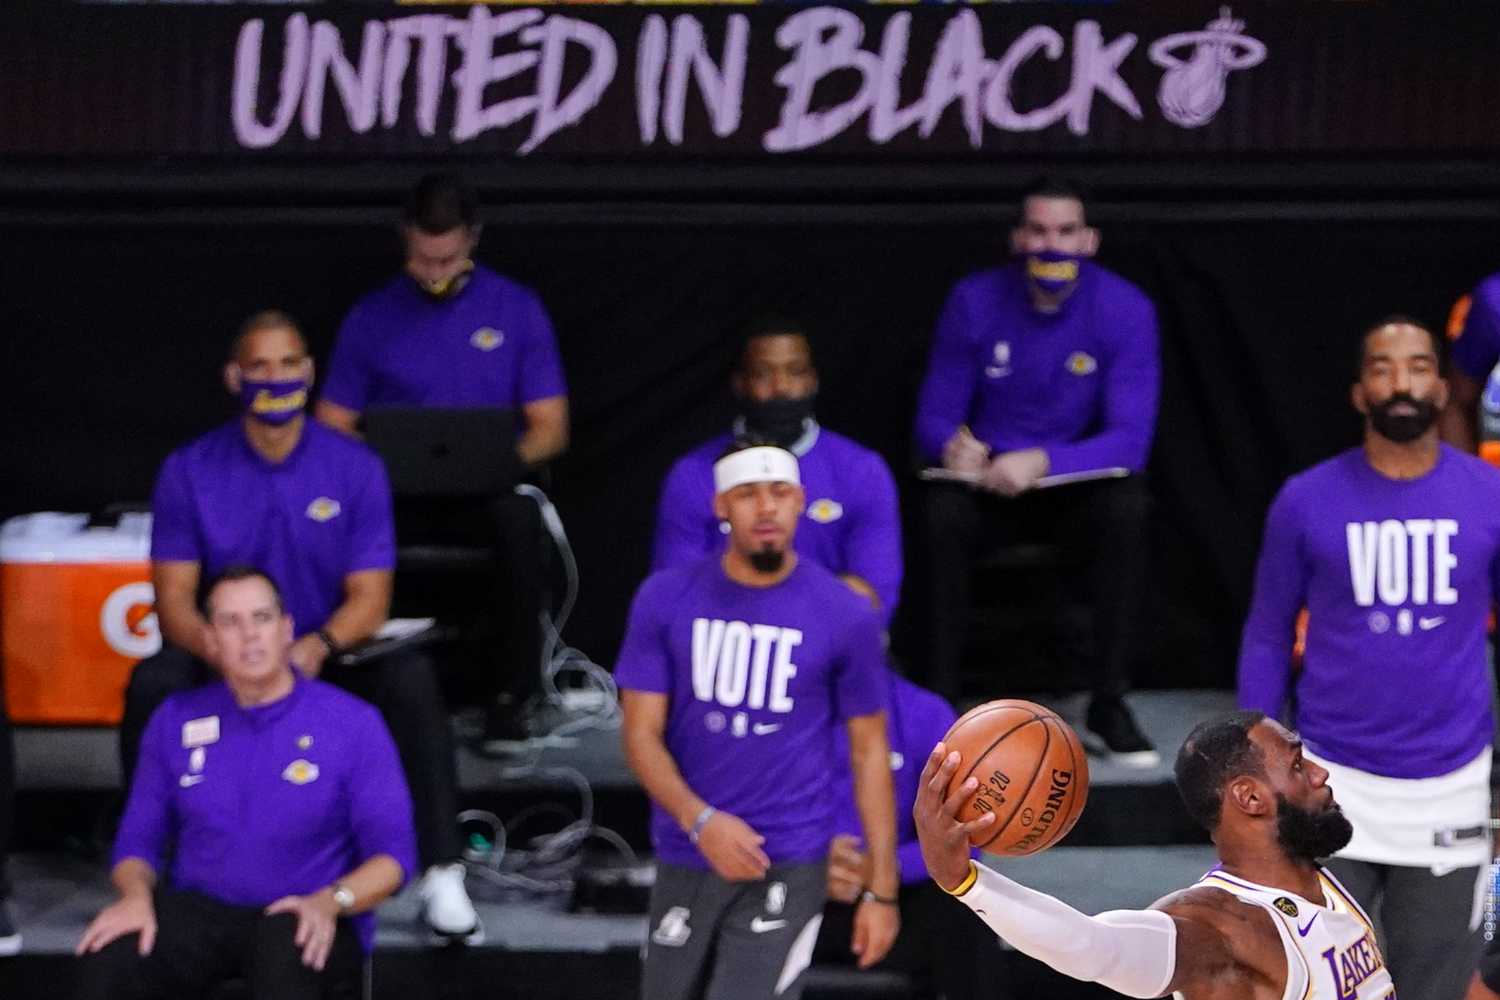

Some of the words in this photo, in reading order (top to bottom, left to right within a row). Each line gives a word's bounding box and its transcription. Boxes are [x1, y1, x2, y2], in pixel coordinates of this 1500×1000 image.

[231, 4, 619, 156] UNITED
[635, 12, 750, 146] IN
[761, 6, 1144, 152] BLACK
[1345, 518, 1459, 607] VOTE
[100, 581, 163, 659] G
[691, 617, 803, 713] VOTE
[1006, 768, 1073, 852] PALDING
